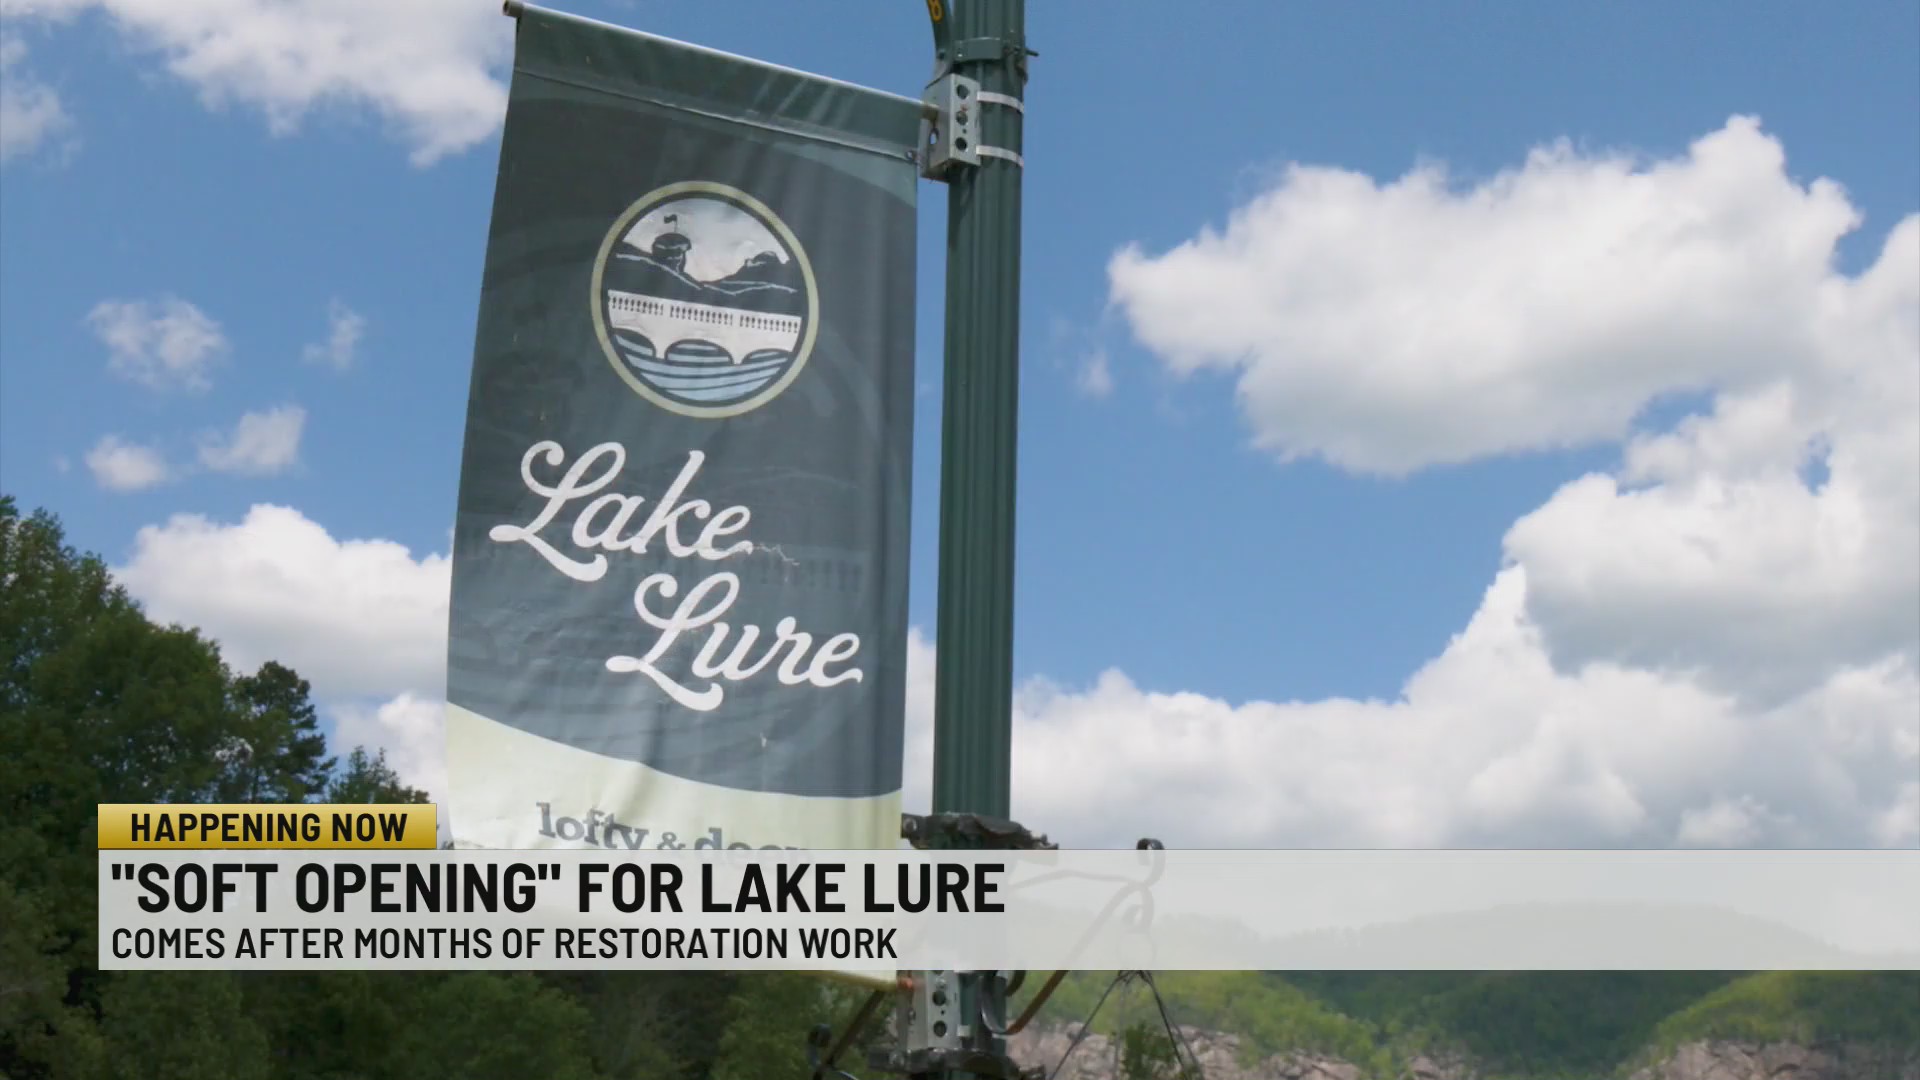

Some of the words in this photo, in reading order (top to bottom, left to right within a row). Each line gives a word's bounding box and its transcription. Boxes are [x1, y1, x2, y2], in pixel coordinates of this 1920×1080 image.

[489, 440, 754, 582] Lake
[604, 571, 864, 712] Lure
[536, 801, 649, 852] lofty
